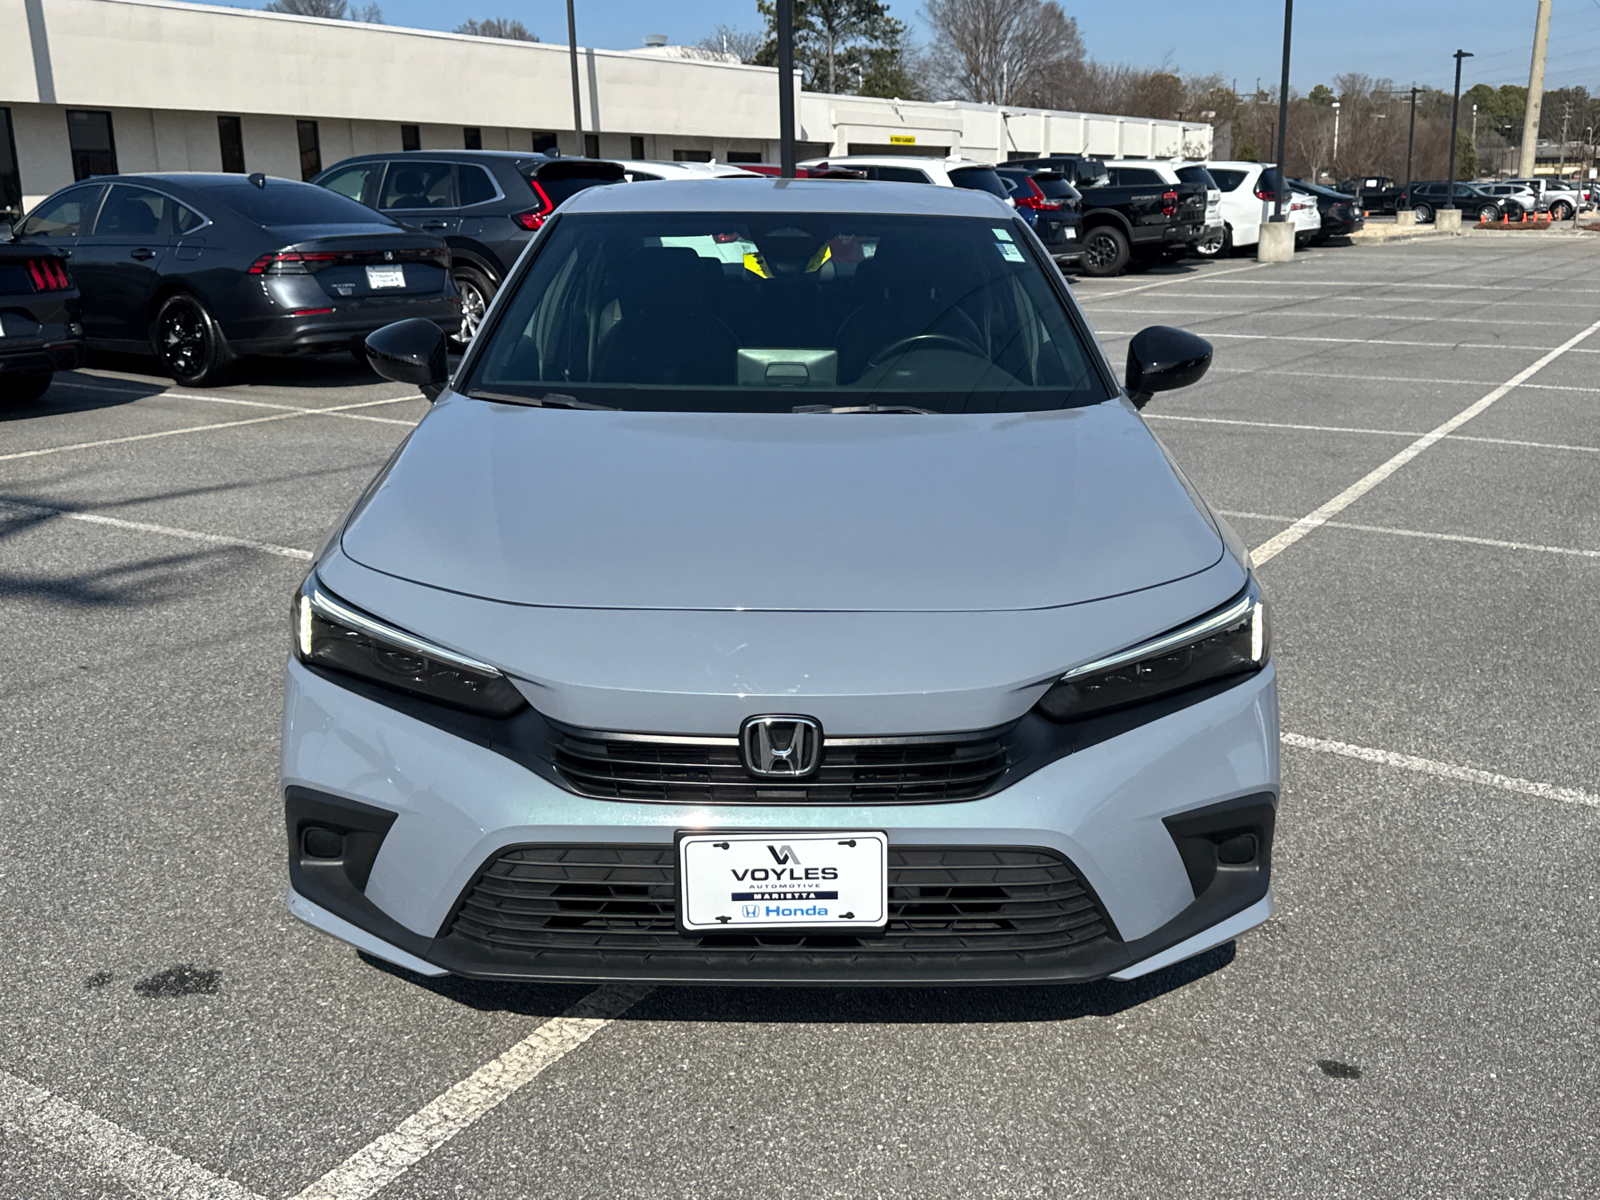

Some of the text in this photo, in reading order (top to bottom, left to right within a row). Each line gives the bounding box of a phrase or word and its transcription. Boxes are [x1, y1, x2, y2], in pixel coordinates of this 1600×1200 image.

[731, 867, 839, 882] VOYLES
[753, 892, 816, 900] MARIETTA
[765, 905, 829, 917] Honda
